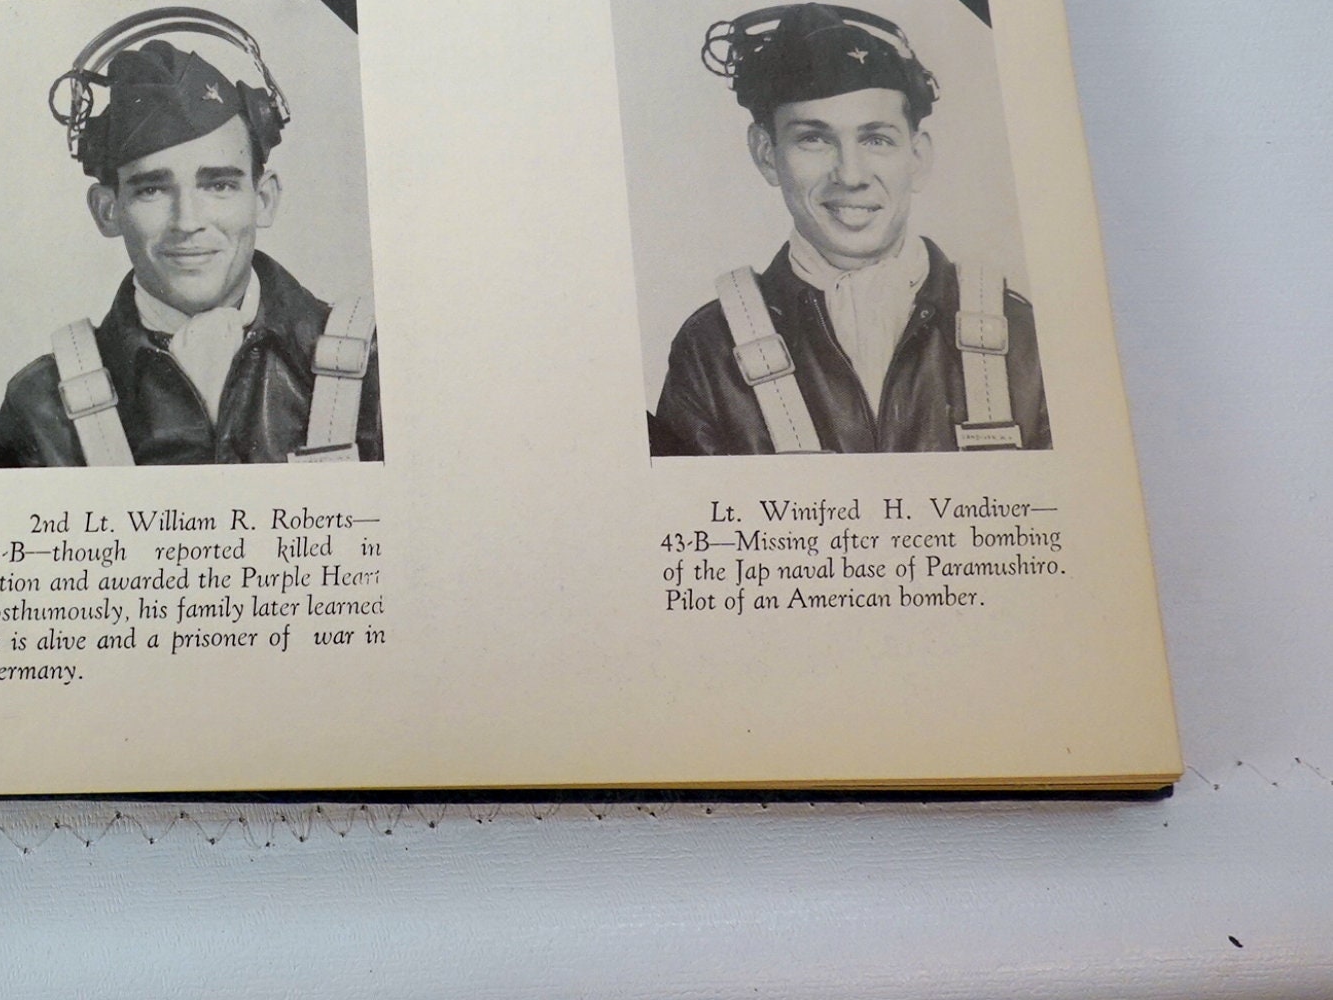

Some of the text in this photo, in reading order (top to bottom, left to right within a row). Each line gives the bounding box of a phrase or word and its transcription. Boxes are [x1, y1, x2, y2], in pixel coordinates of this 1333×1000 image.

[29, 510, 71, 534] 2nd
[83, 510, 115, 534] Lt.
[126, 508, 218, 533] William
[229, 508, 256, 531] R.
[710, 500, 742, 523] Lt.
[758, 498, 861, 527] Winifred
[882, 497, 912, 521] H.
[154, 536, 247, 567] reported
[276, 533, 334, 564] killed
[360, 536, 382, 557] in
[829, 527, 880, 555] after
[890, 531, 958, 549] recent
[969, 524, 1063, 553] bombing
[49, 568, 90, 592] and
[97, 566, 191, 592] awarded
[197, 566, 232, 590] the
[240, 564, 312, 595] Purple
[662, 552, 1066, 588] of the Jap naval base of Paramushiro.
[138, 596, 168, 620] his
[176, 594, 245, 625] family
[250, 594, 301, 618] later
[665, 583, 985, 616] Pilot of an American bomber.
